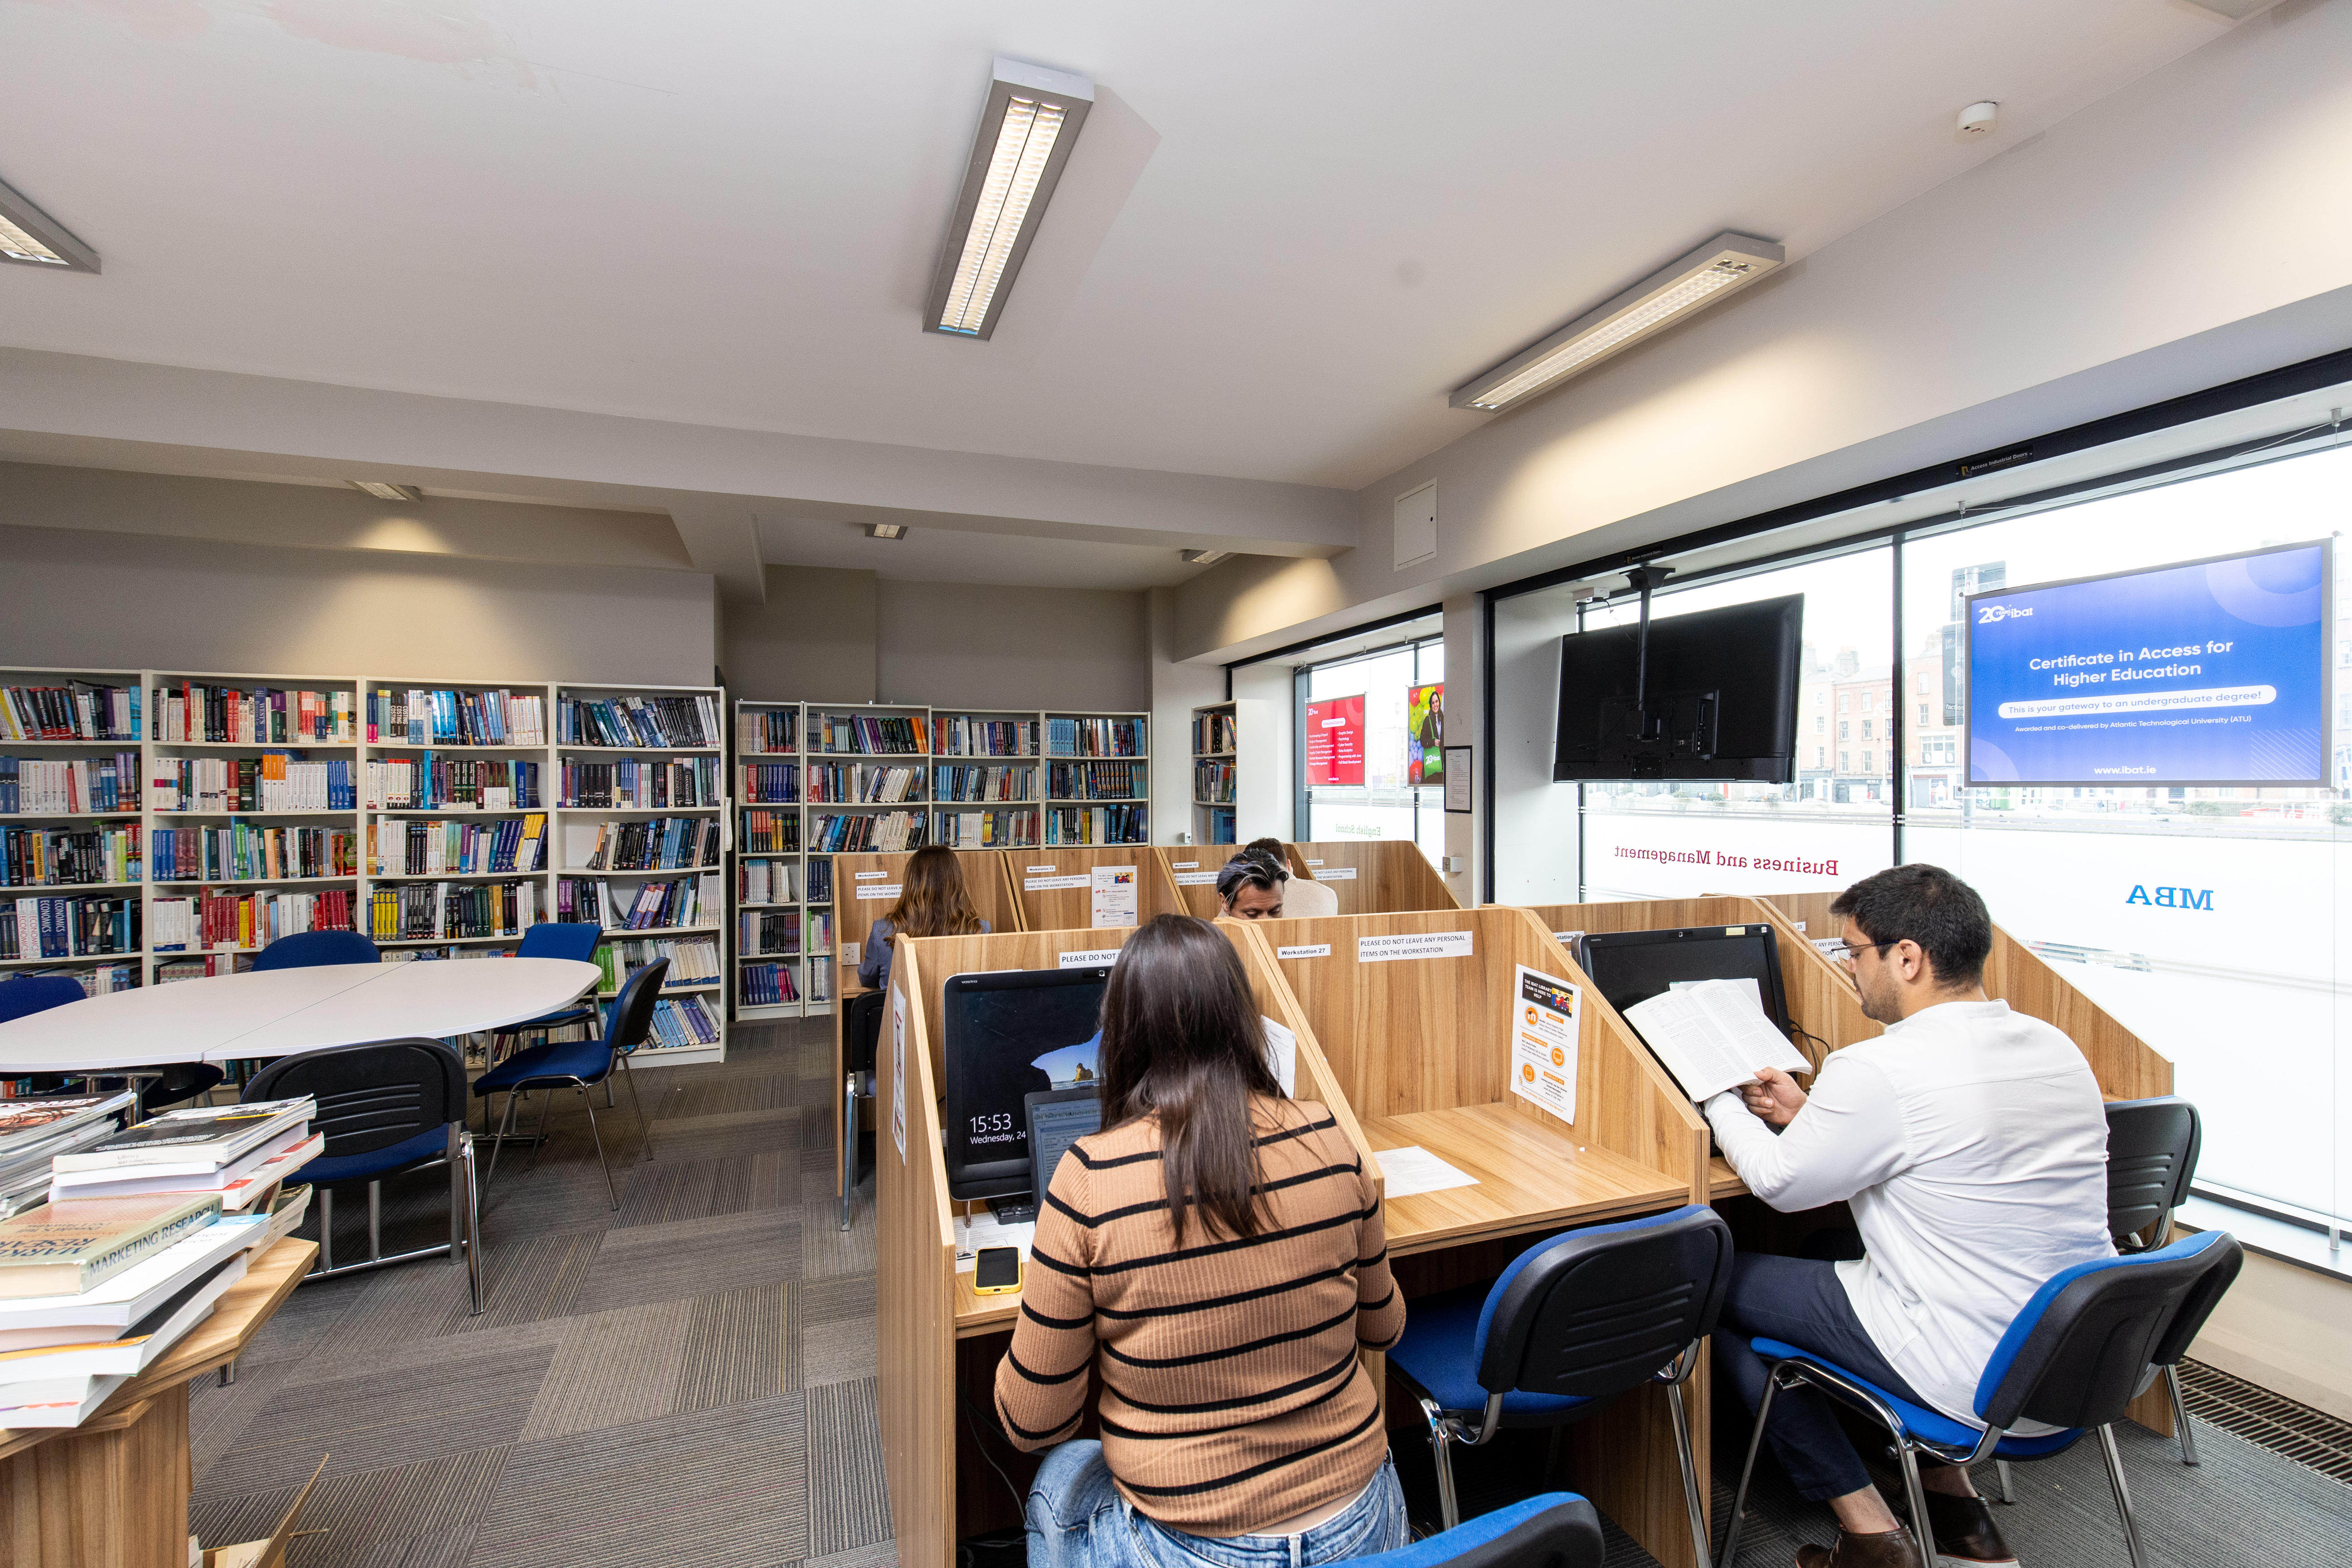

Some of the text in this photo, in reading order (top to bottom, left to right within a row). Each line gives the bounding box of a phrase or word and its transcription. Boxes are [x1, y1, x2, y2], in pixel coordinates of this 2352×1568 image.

[1989, 456, 2012, 465] Industrial
[2011, 607, 2033, 618] ibat
[2029, 641, 2233, 670] Certificate in Access for
[2054, 663, 2201, 688] Higher Education
[2037, 705, 2056, 713] your
[2059, 702, 2100, 712] gateway
[2131, 695, 2212, 706] undergraduate
[2216, 691, 2261, 702] degree!
[2057, 722, 2099, 730] co-delivered
[2139, 719, 2189, 727] Technological
[2094, 765, 2157, 775] www.ibat.ie
[40, 900, 51, 933] ECONOMICS
[54, 900, 65, 932] ECONOMICS
[19, 916, 28, 952] ECONOMICS
[30, 916, 39, 952] ECONOMICS
[1062, 954, 1087, 962] PLEASE
[1539, 984, 1552, 992] LIBRARY
[1522, 1032, 1547, 1047] LEARNING PORTAL
[1545, 1073, 1558, 1081] CONTACT
[969, 1113, 1012, 1133] 15:53
[970, 1131, 1026, 1145] Wednesday, 24
[90, 1204, 215, 1277] MARKETING RESEARCH
